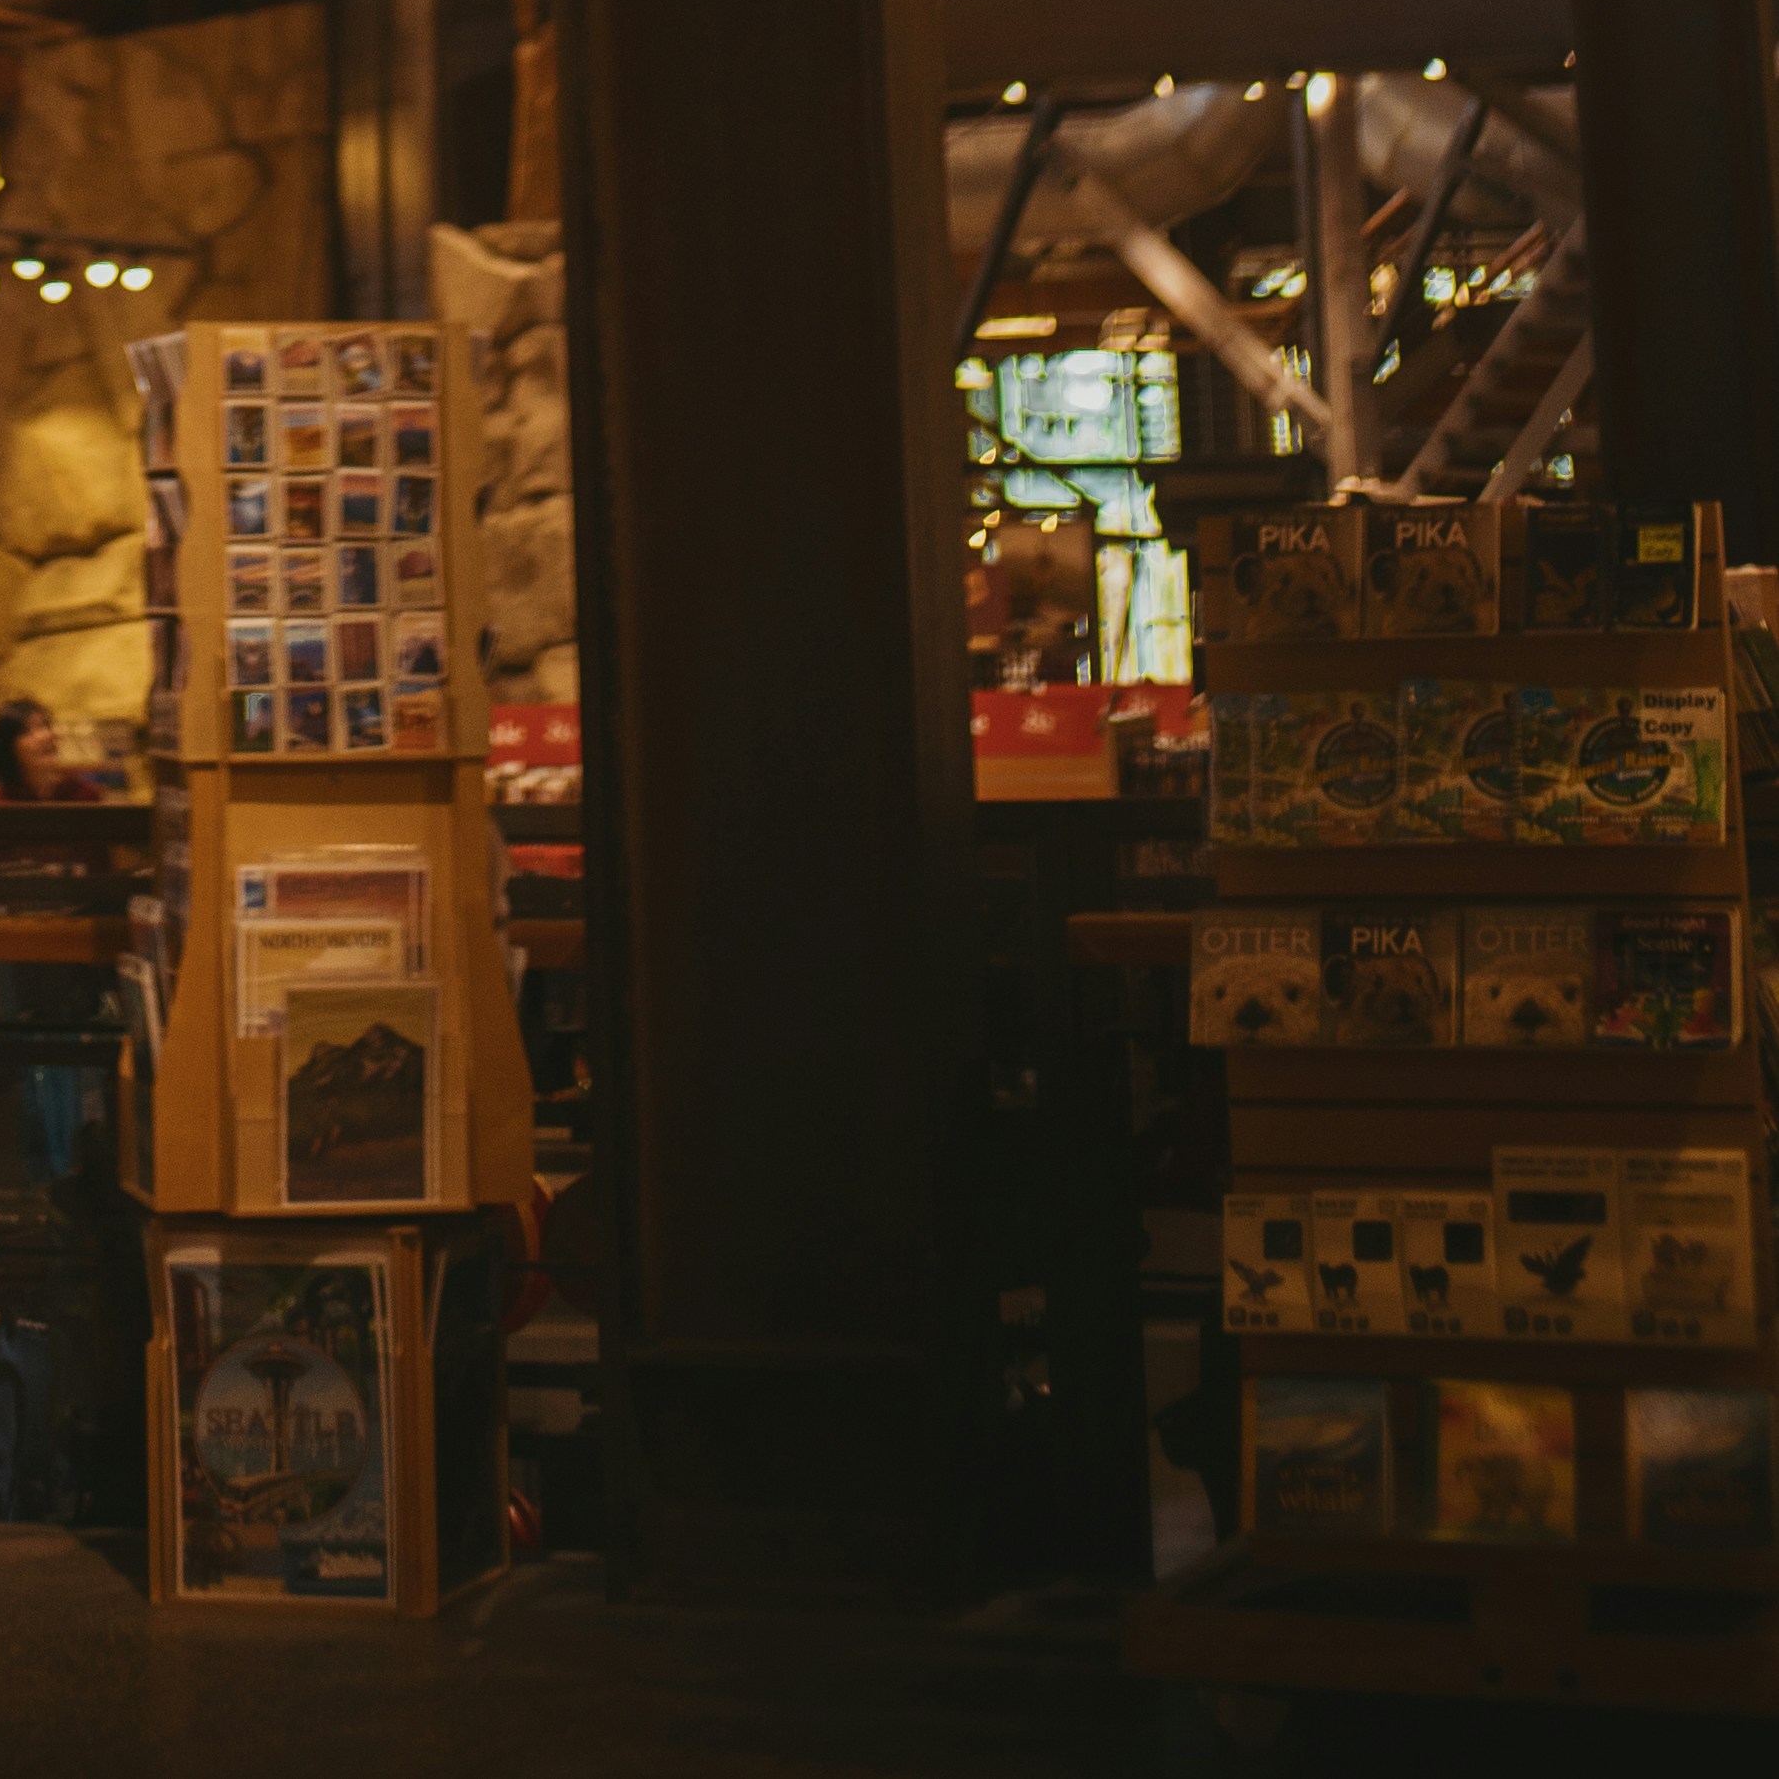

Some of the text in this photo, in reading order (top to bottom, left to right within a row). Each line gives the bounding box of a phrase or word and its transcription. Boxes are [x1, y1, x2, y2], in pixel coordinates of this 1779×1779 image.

[1258, 523, 1331, 554] PIKA
[1394, 519, 1468, 548] PIKA
[1644, 693, 1717, 711] Display
[1644, 719, 1694, 736] Copy
[1200, 926, 1311, 955] OTTER
[1350, 926, 1423, 955] PIKA
[1475, 924, 1589, 953] OTTER
[206, 1407, 358, 1438] SEATTLE
